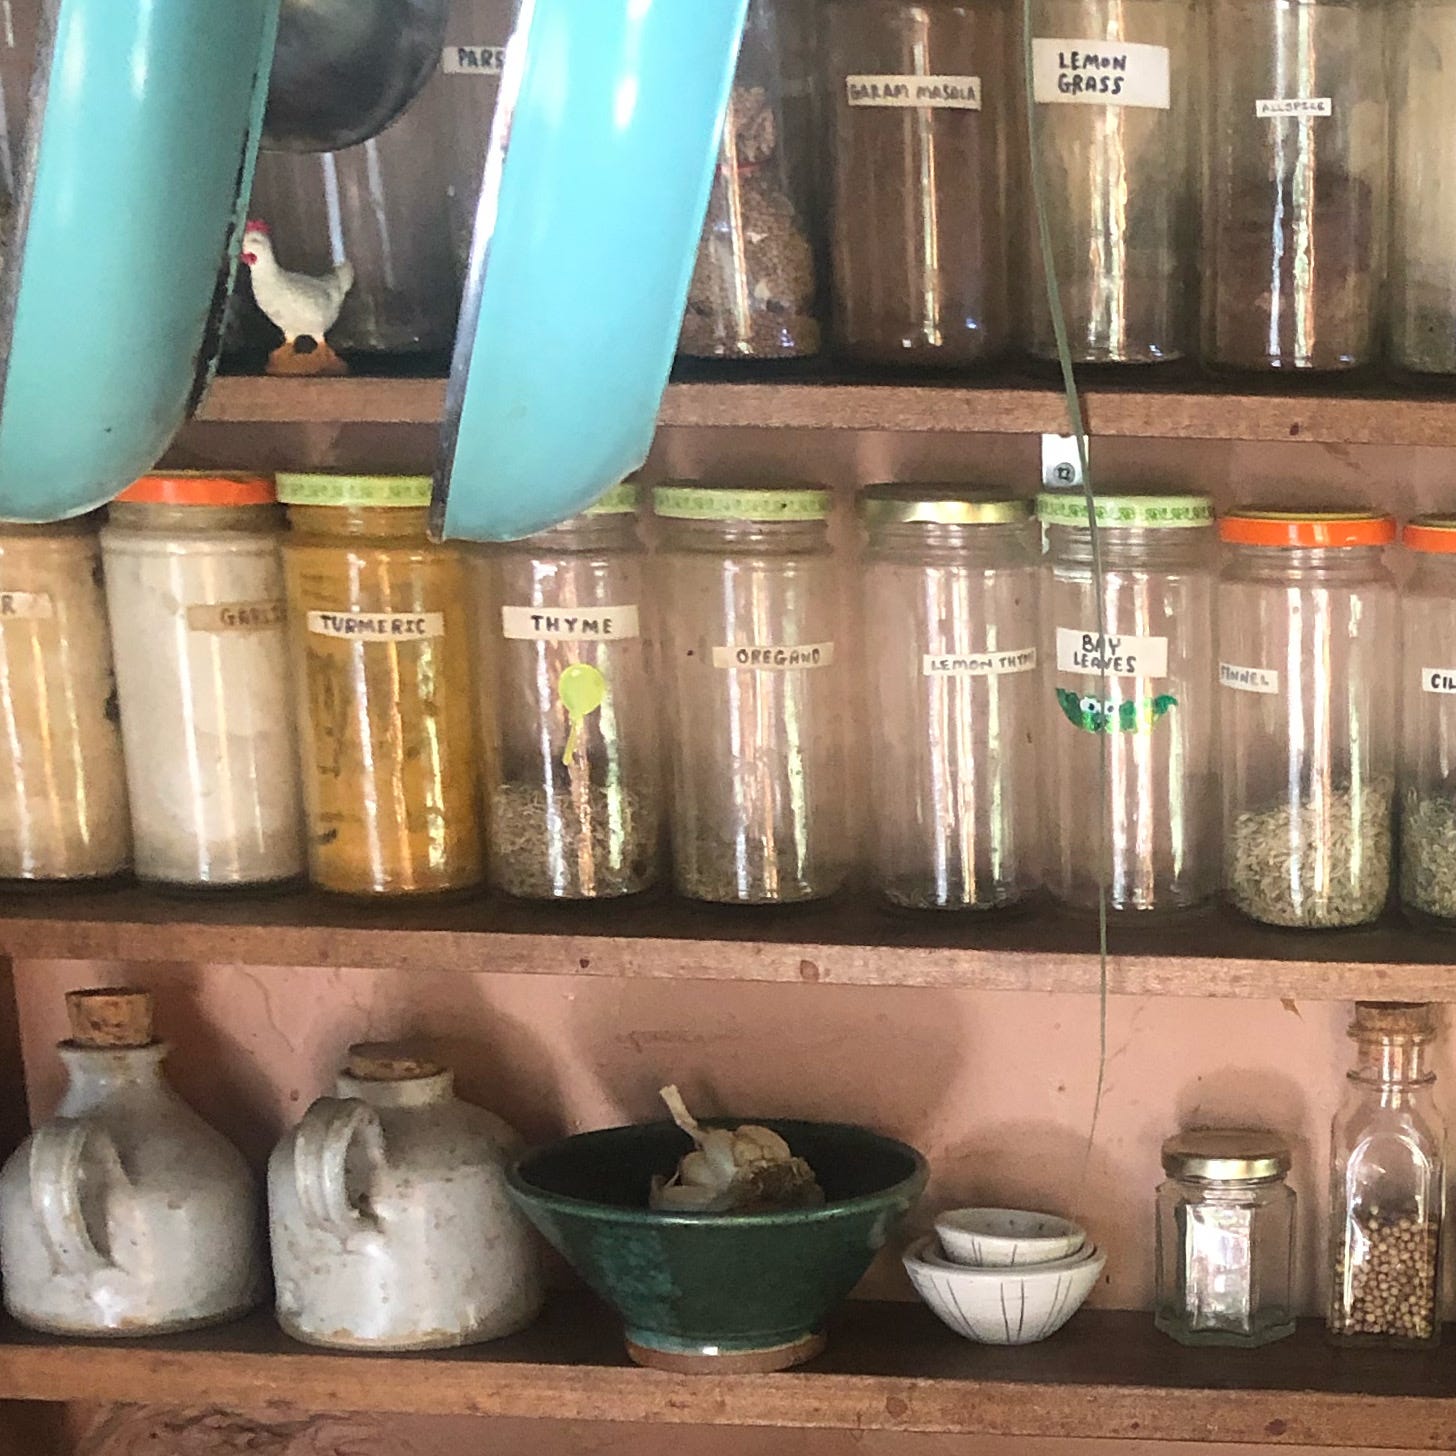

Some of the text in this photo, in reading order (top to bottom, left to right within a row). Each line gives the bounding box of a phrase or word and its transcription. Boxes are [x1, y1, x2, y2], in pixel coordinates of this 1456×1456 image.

[1058, 52, 1127, 72] LEMON
[850, 84, 909, 100] GARAM
[1058, 75, 1125, 95] GRASS
[319, 614, 426, 635] TURMERIC
[530, 614, 613, 634] THYME
[1081, 634, 1121, 655] BAY
[735, 648, 821, 666] OREGANO
[931, 658, 992, 673] LEMON
[1072, 653, 1136, 672] LEAVES
